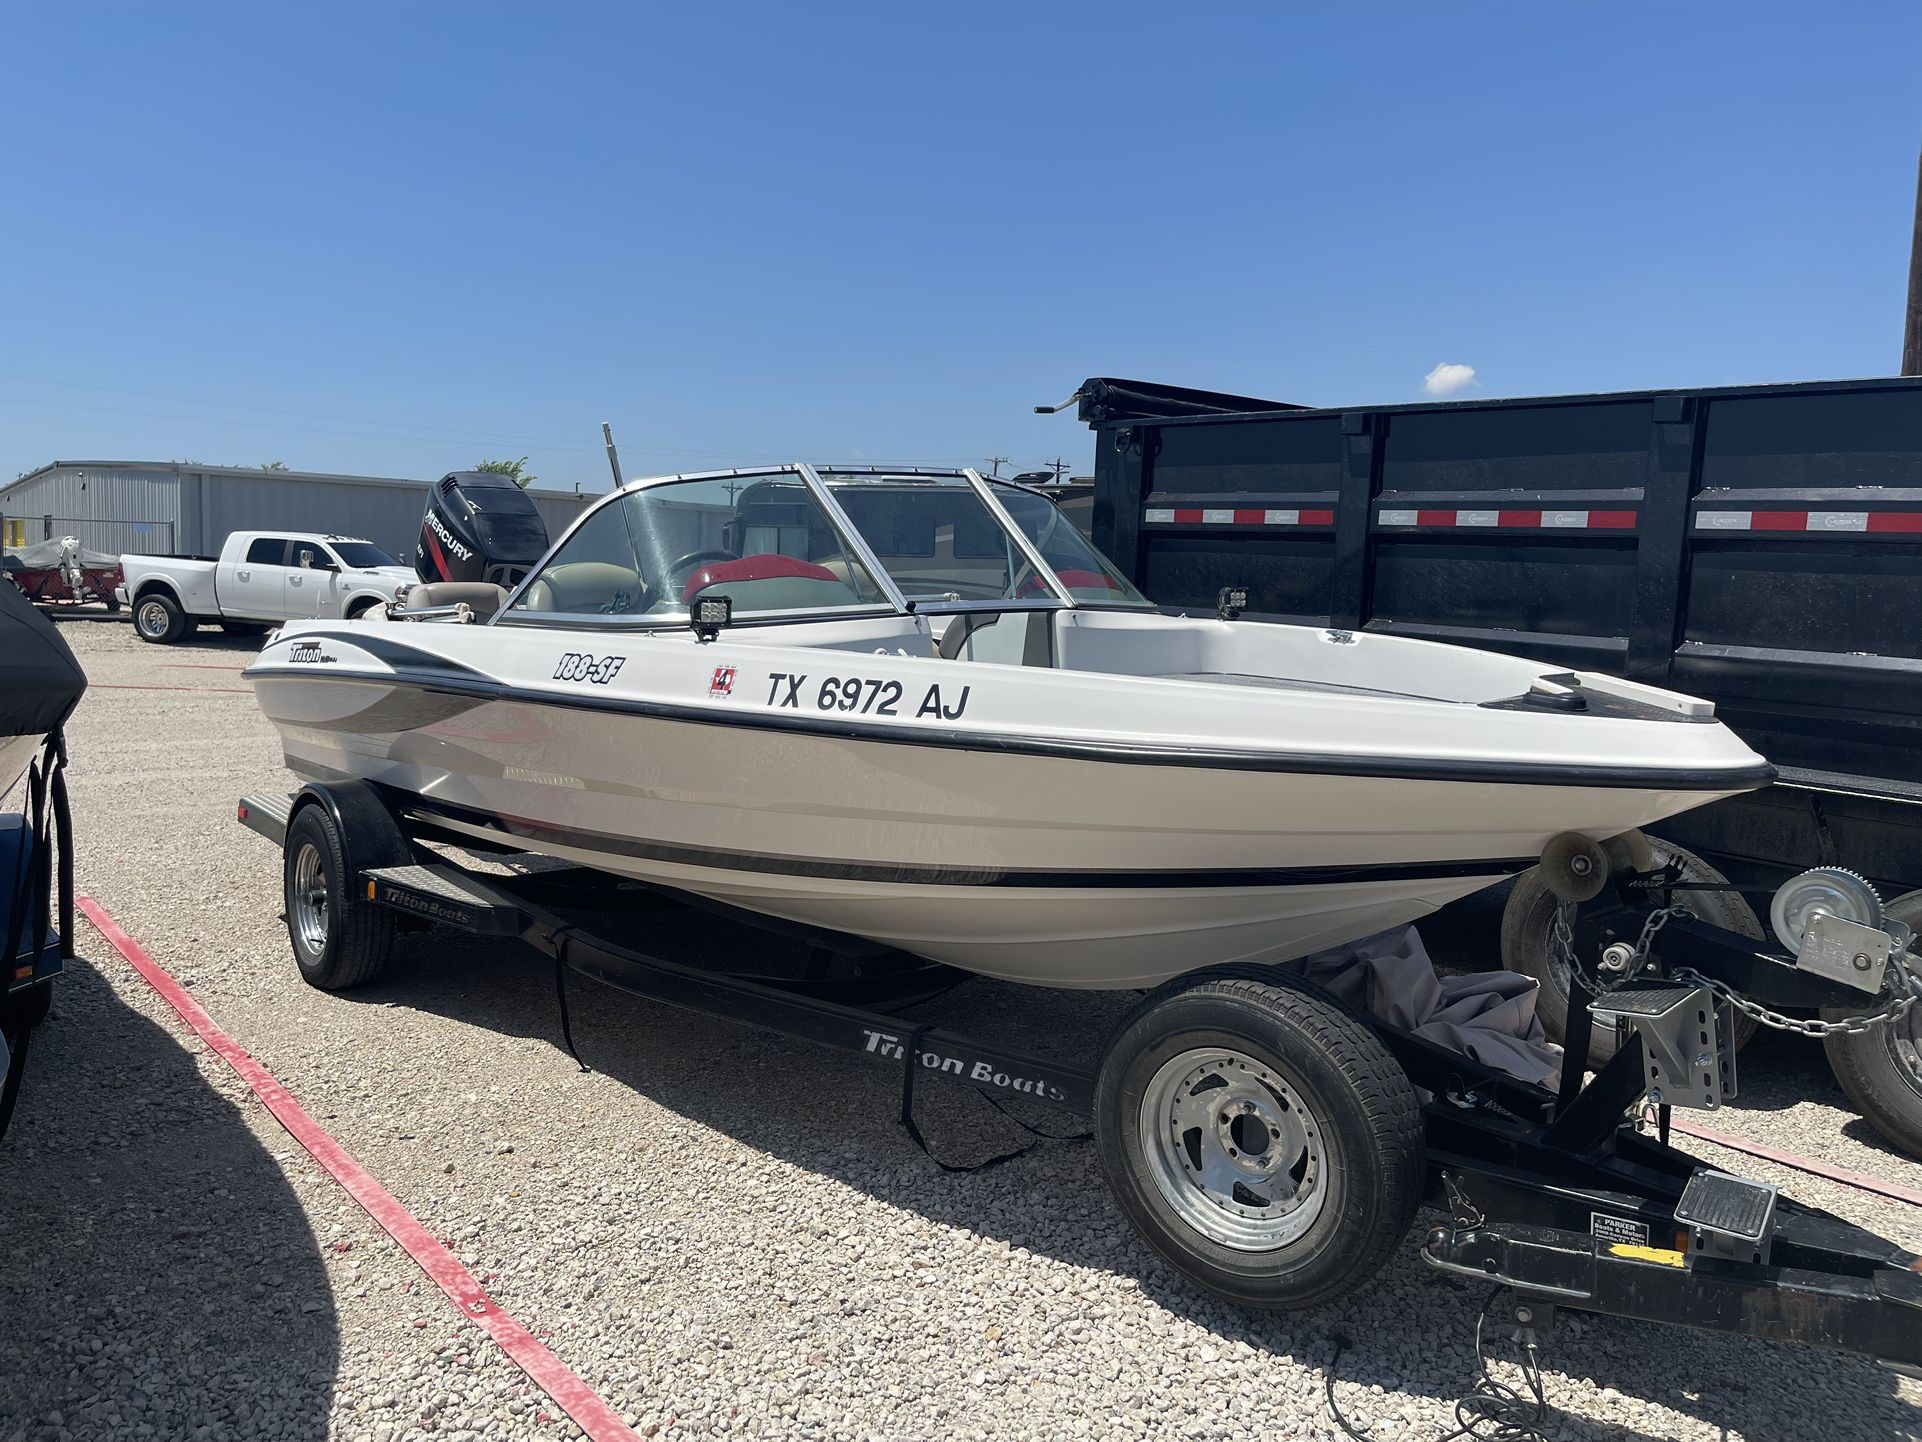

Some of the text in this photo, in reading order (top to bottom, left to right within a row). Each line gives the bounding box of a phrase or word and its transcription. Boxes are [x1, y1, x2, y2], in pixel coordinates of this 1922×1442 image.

[424, 508, 473, 562] MERCURY
[289, 642, 321, 663] Triton
[553, 653, 627, 685] 188-SF
[767, 673, 970, 721] TX 6972 AJ
[864, 1030, 964, 1075] Trion
[1594, 1222, 1613, 1231] Boats
[1621, 1228, 1645, 1239] Motors
[1604, 1219, 1635, 1231] PARKER
